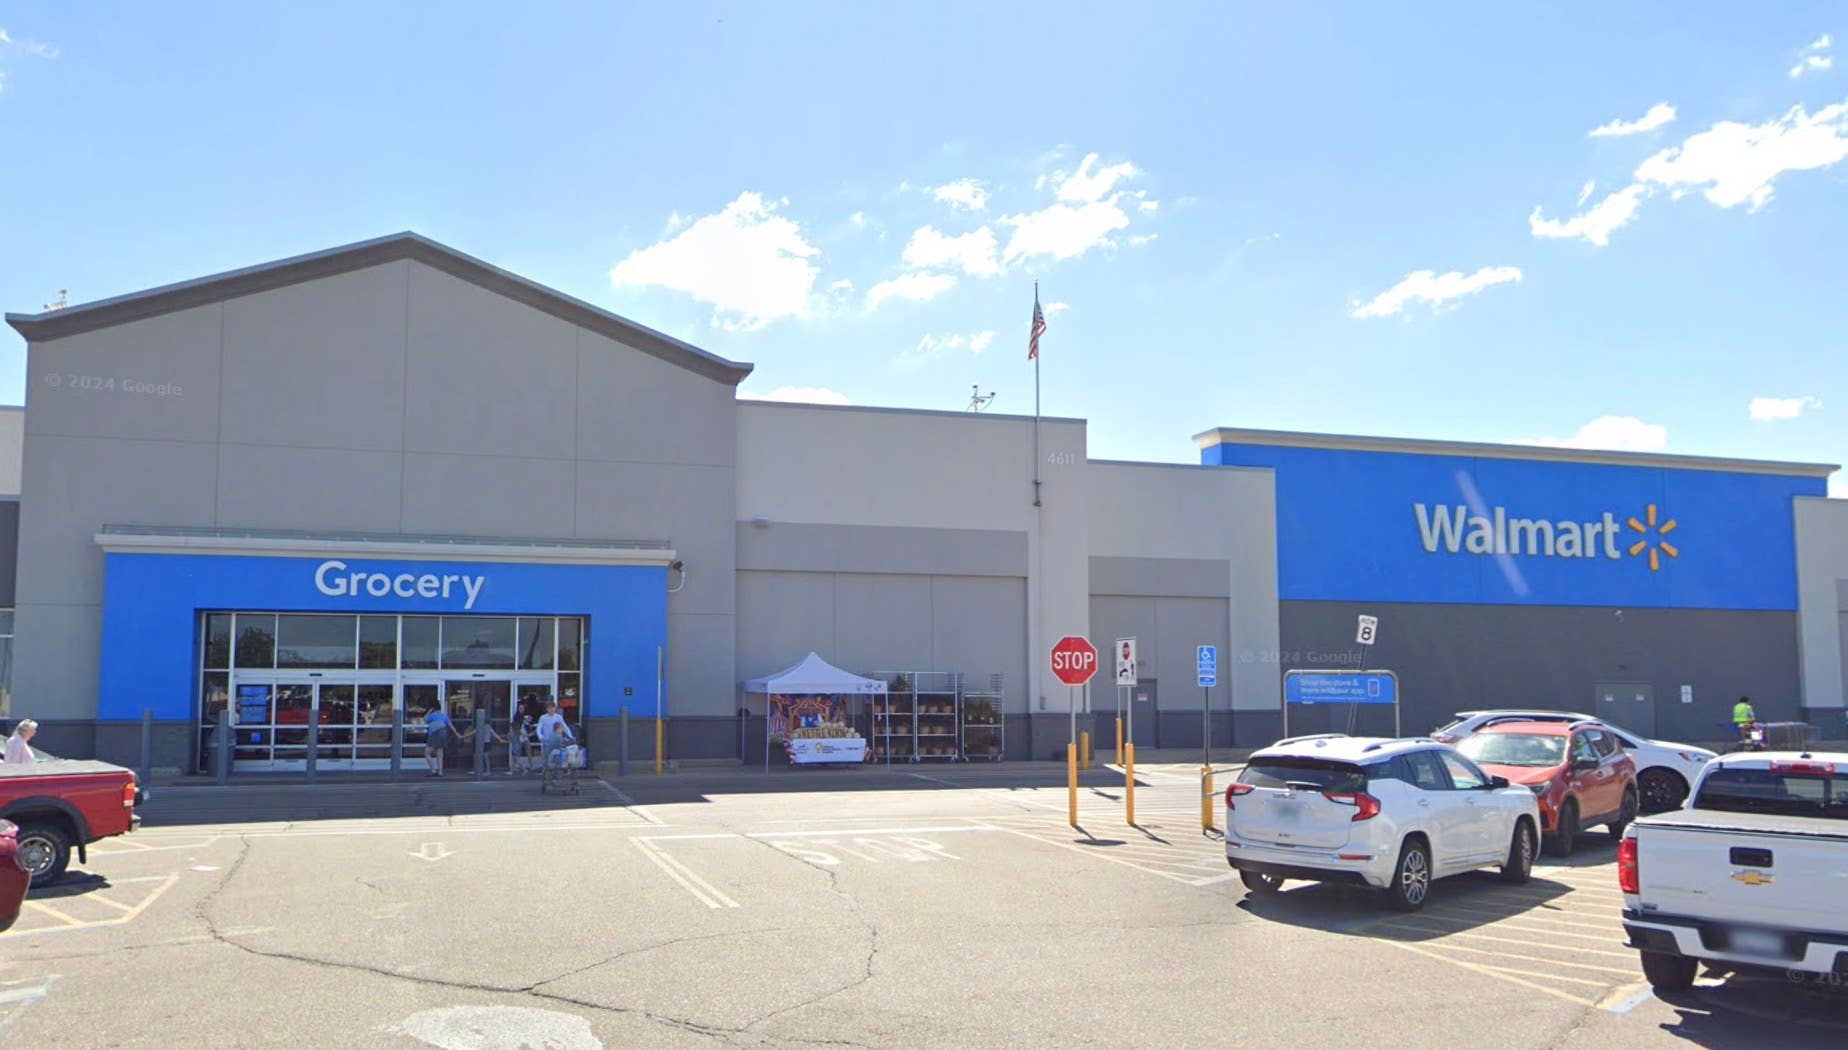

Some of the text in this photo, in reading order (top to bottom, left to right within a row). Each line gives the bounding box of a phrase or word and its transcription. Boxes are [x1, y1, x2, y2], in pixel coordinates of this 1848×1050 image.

[1047, 451, 1075, 465] 4611
[1413, 502, 1622, 560] Walmart
[314, 559, 486, 610] Grocery
[1361, 626, 1372, 641] 8
[1053, 651, 1095, 670] STOP
